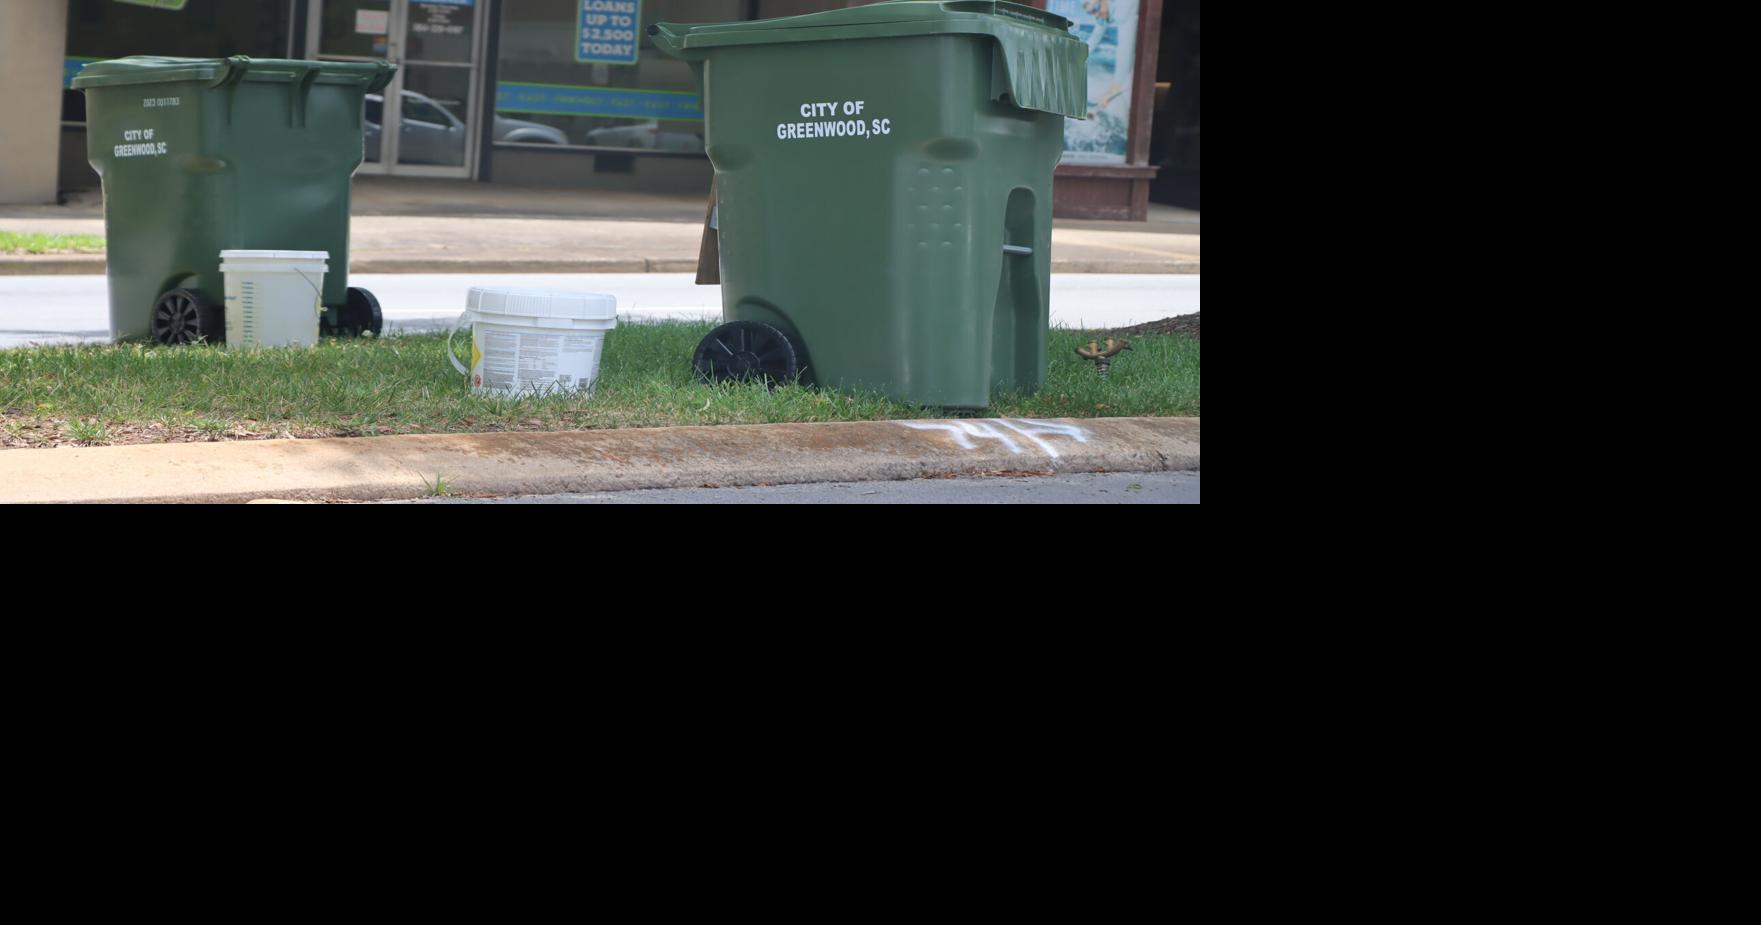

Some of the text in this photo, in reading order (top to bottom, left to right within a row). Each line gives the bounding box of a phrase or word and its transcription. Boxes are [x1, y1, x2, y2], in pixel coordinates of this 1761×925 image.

[584, 0, 635, 14] LOANS
[586, 14, 632, 27] UP TO
[581, 42, 633, 56] TODAY
[800, 100, 865, 118] CITY OF
[124, 128, 154, 141] CITY OF
